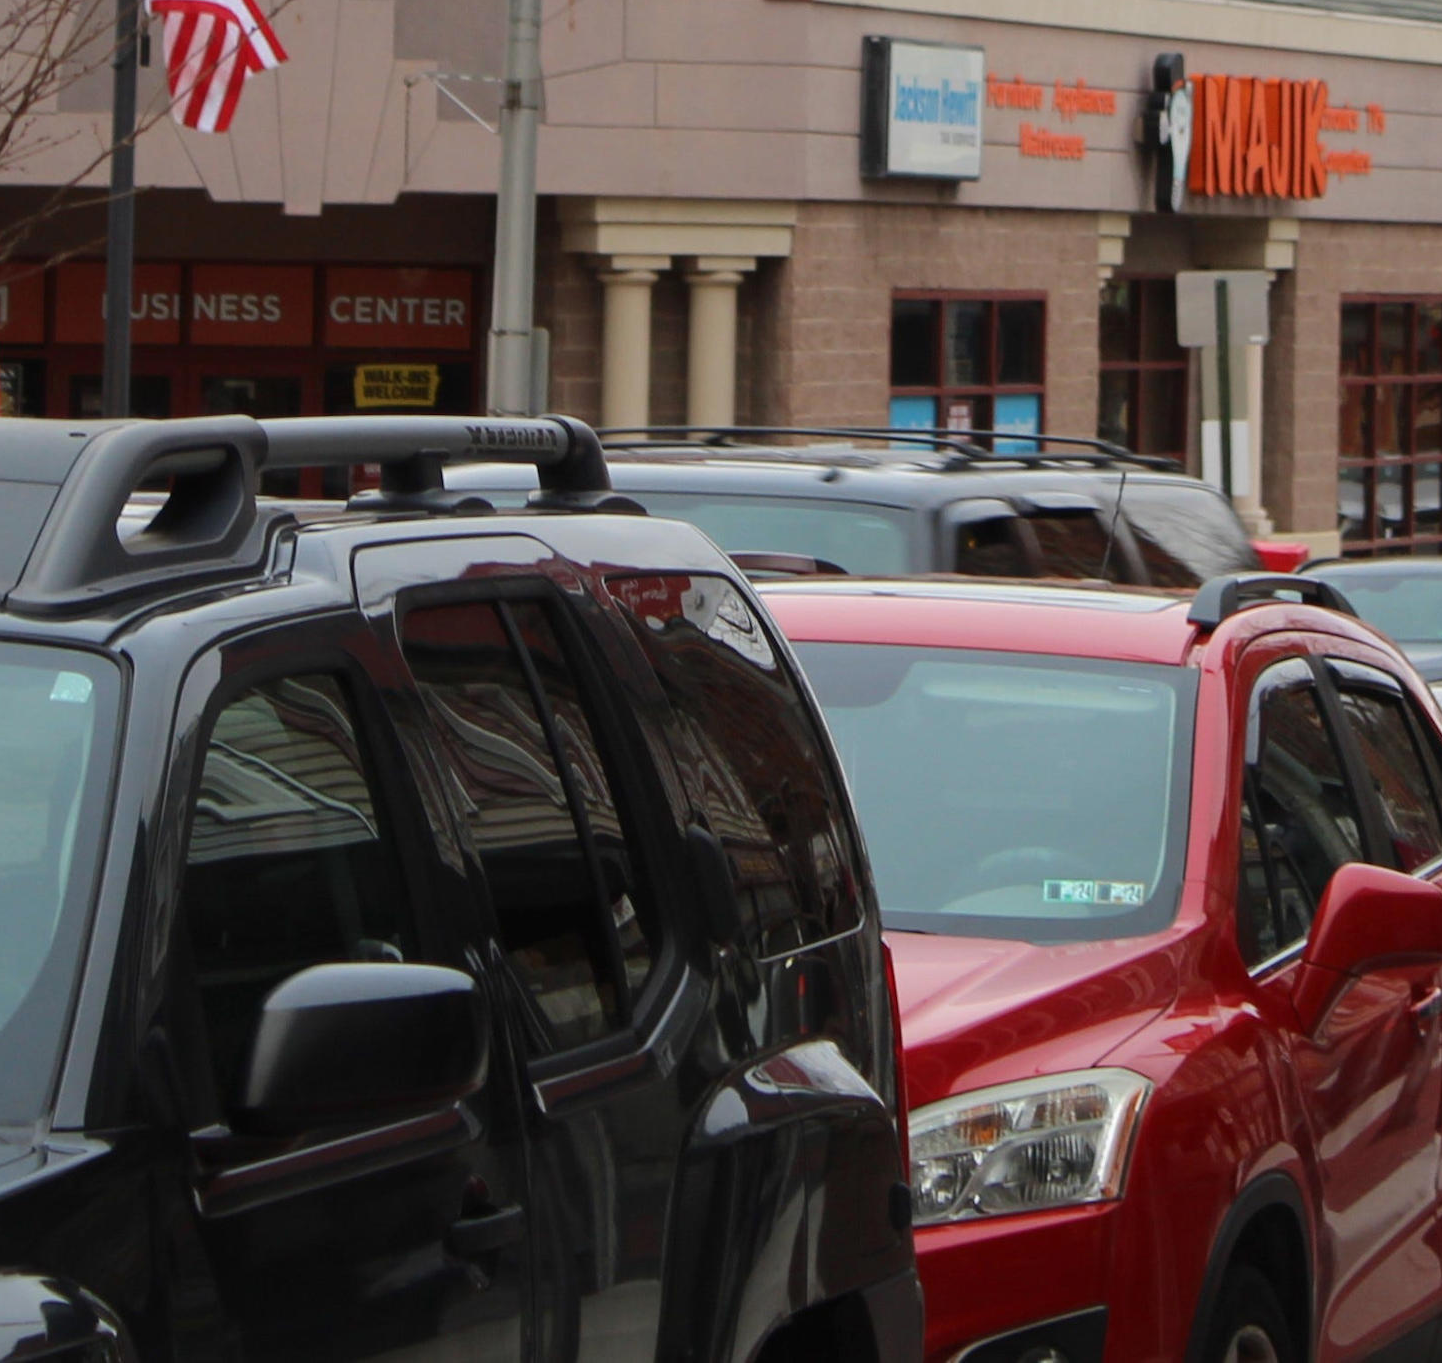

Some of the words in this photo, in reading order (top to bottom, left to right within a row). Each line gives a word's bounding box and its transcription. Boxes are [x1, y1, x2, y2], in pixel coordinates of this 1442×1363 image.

[1200, 74, 1329, 200] MAJIK
[102, 292, 282, 322] USINESS
[329, 296, 467, 325] CENTER
[364, 370, 430, 385] WALK-INS
[363, 385, 430, 400] WELCOME
